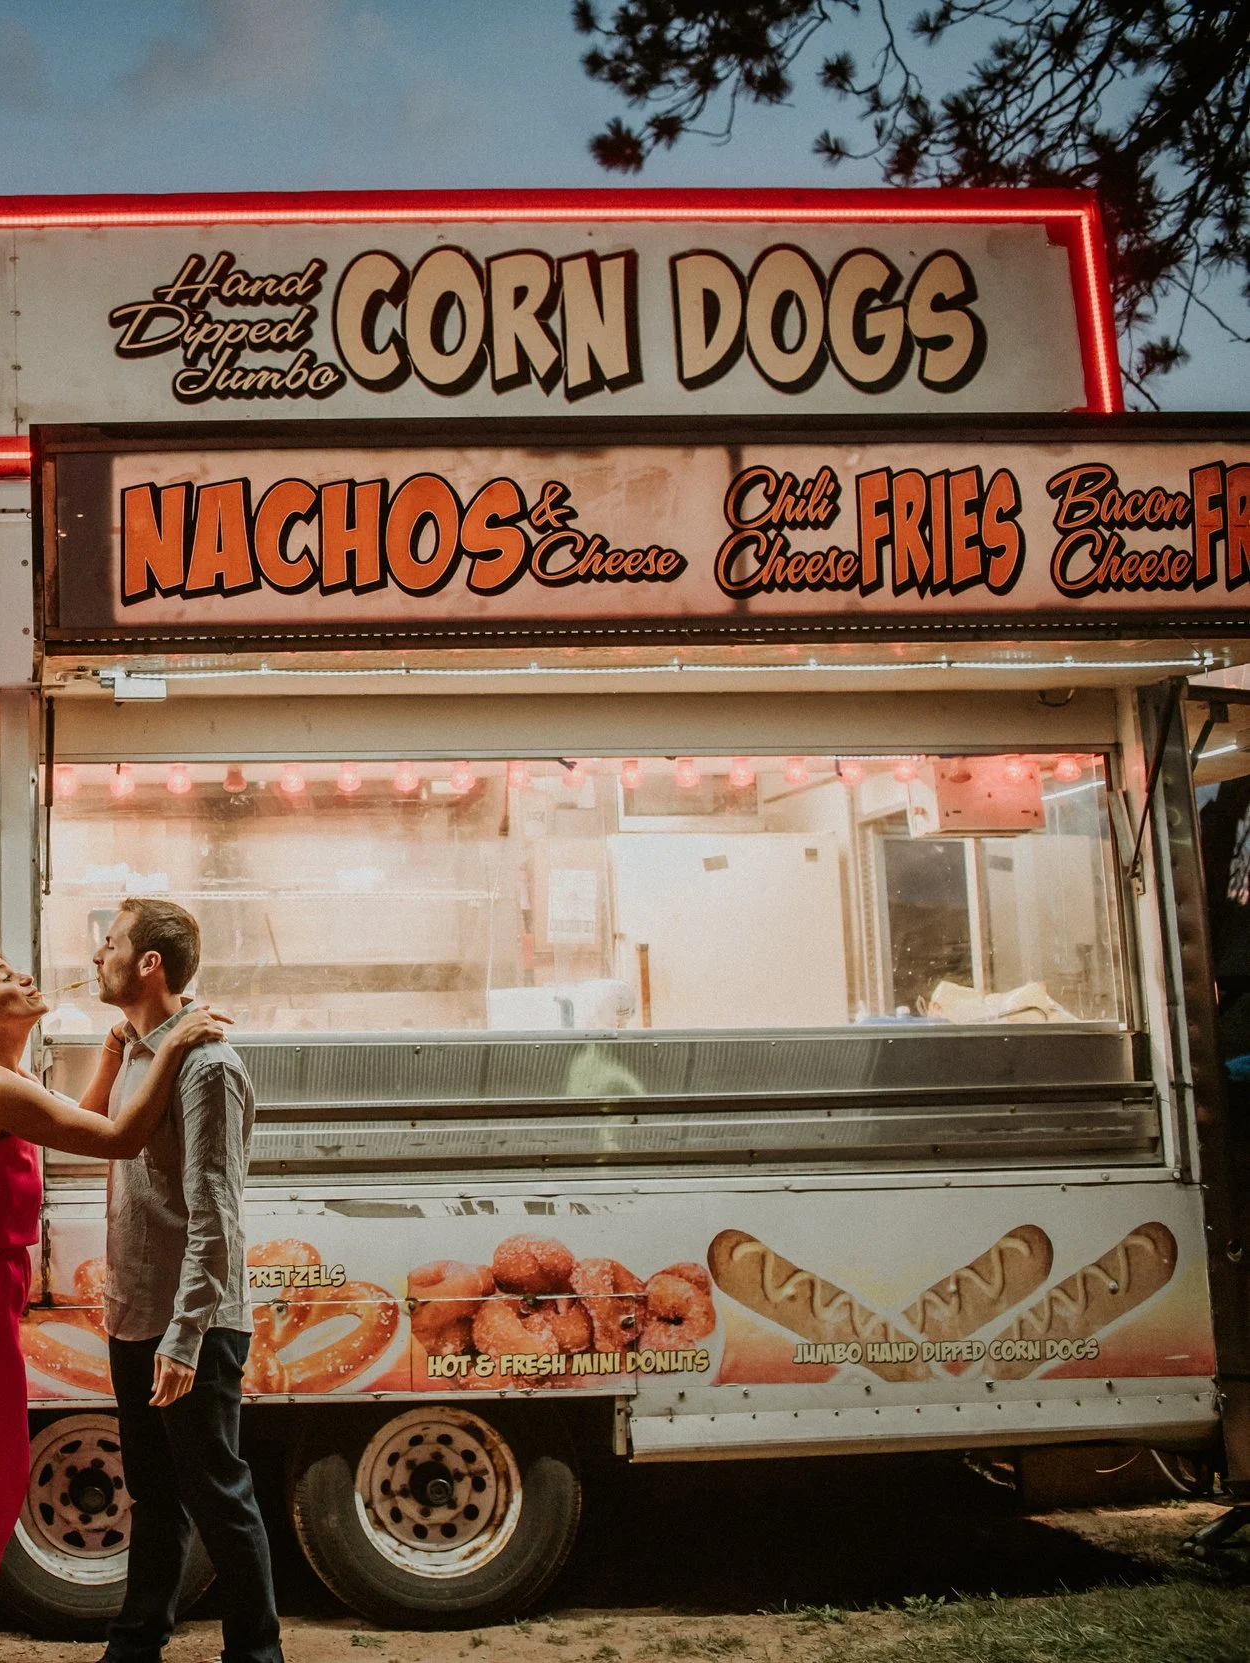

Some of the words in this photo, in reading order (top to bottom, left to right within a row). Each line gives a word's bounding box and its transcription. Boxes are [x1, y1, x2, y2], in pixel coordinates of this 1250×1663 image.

[153, 250, 328, 305] Hand
[108, 303, 318, 366] Dipped
[332, 245, 644, 403] CORN
[669, 243, 988, 395] DOGS
[172, 346, 347, 404] Jumbo
[723, 464, 841, 531] Chili
[1046, 462, 1192, 533] Bacon
[120, 472, 529, 607] NACHOS
[529, 480, 578, 534] &
[528, 529, 688, 588] Cheese
[714, 526, 860, 599] Cheese
[854, 464, 1022, 599] FRIES
[1050, 526, 1194, 598] Cheese
[247, 1263, 346, 1289] PRETZELS
[427, 1354, 472, 1378] HOT
[474, 1354, 495, 1377] &
[499, 1353, 567, 1377] FRESH
[571, 1352, 620, 1375] MINI
[626, 1349, 710, 1373] DONUTS
[792, 1342, 863, 1365] JUMBO
[866, 1341, 918, 1363] HAND
[921, 1341, 987, 1363] DIPPED
[989, 1340, 1041, 1362] CORN
[1045, 1339, 1099, 1360] DOGS
